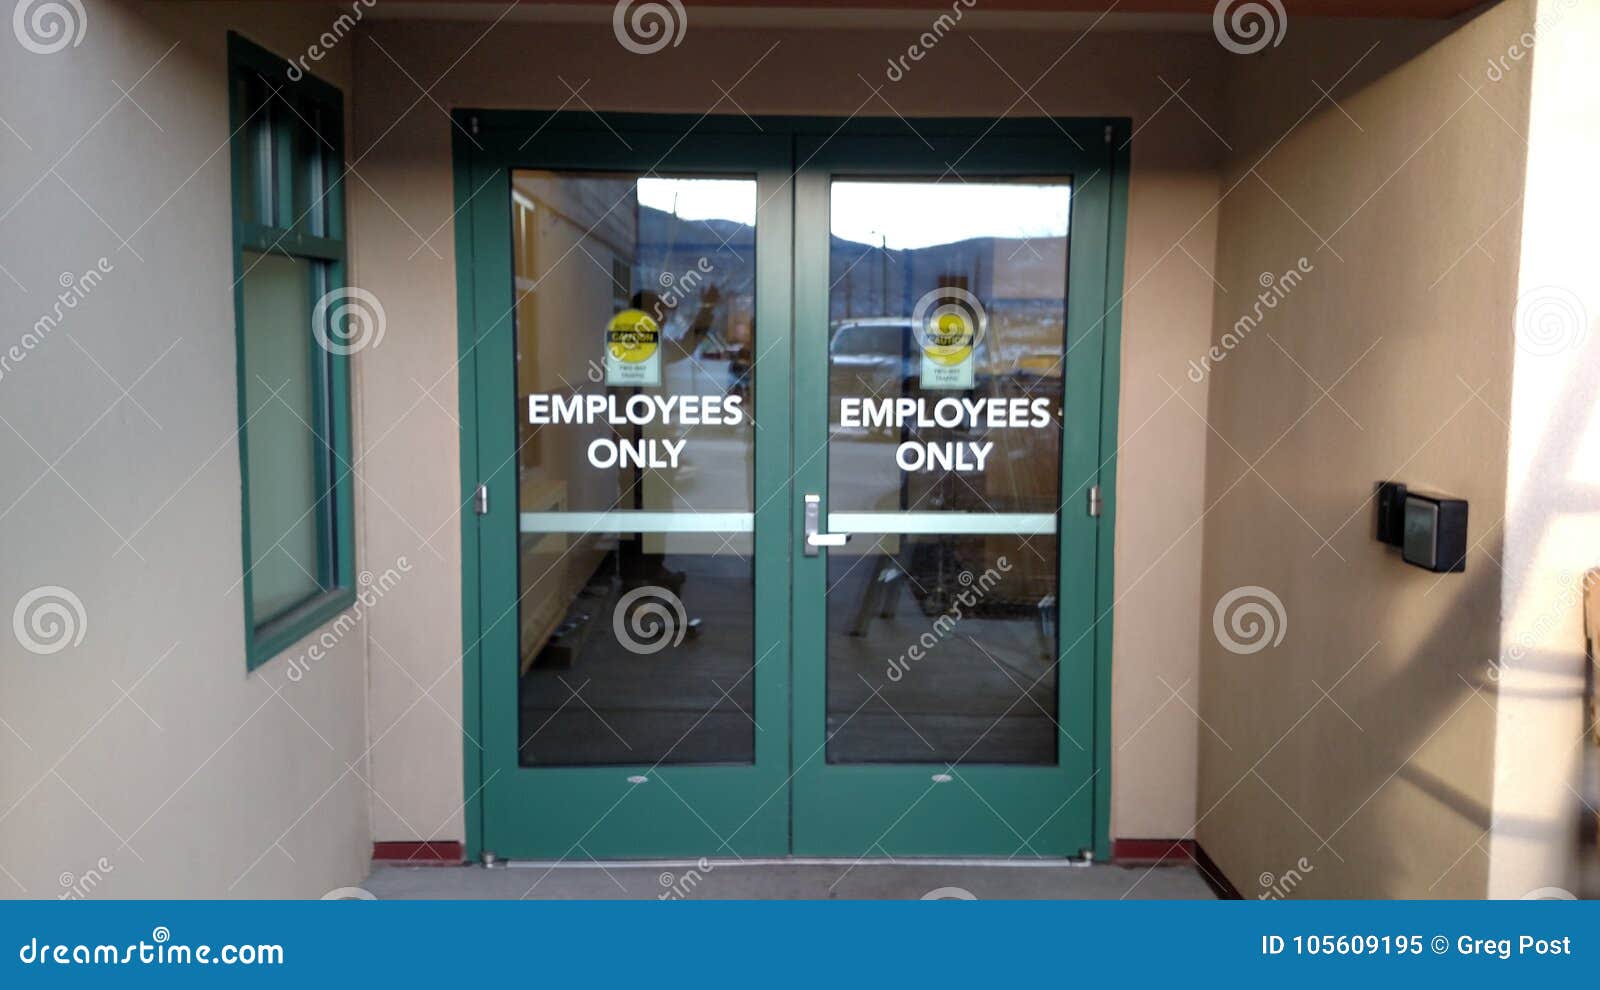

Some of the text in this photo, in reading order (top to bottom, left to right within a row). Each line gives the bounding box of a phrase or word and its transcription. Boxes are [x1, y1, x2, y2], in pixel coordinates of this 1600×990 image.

[528, 394, 743, 425] EMPLOYEES
[840, 397, 1050, 428] EMPLOYEES
[587, 438, 687, 469] ONLY
[895, 441, 994, 471] ONLY
